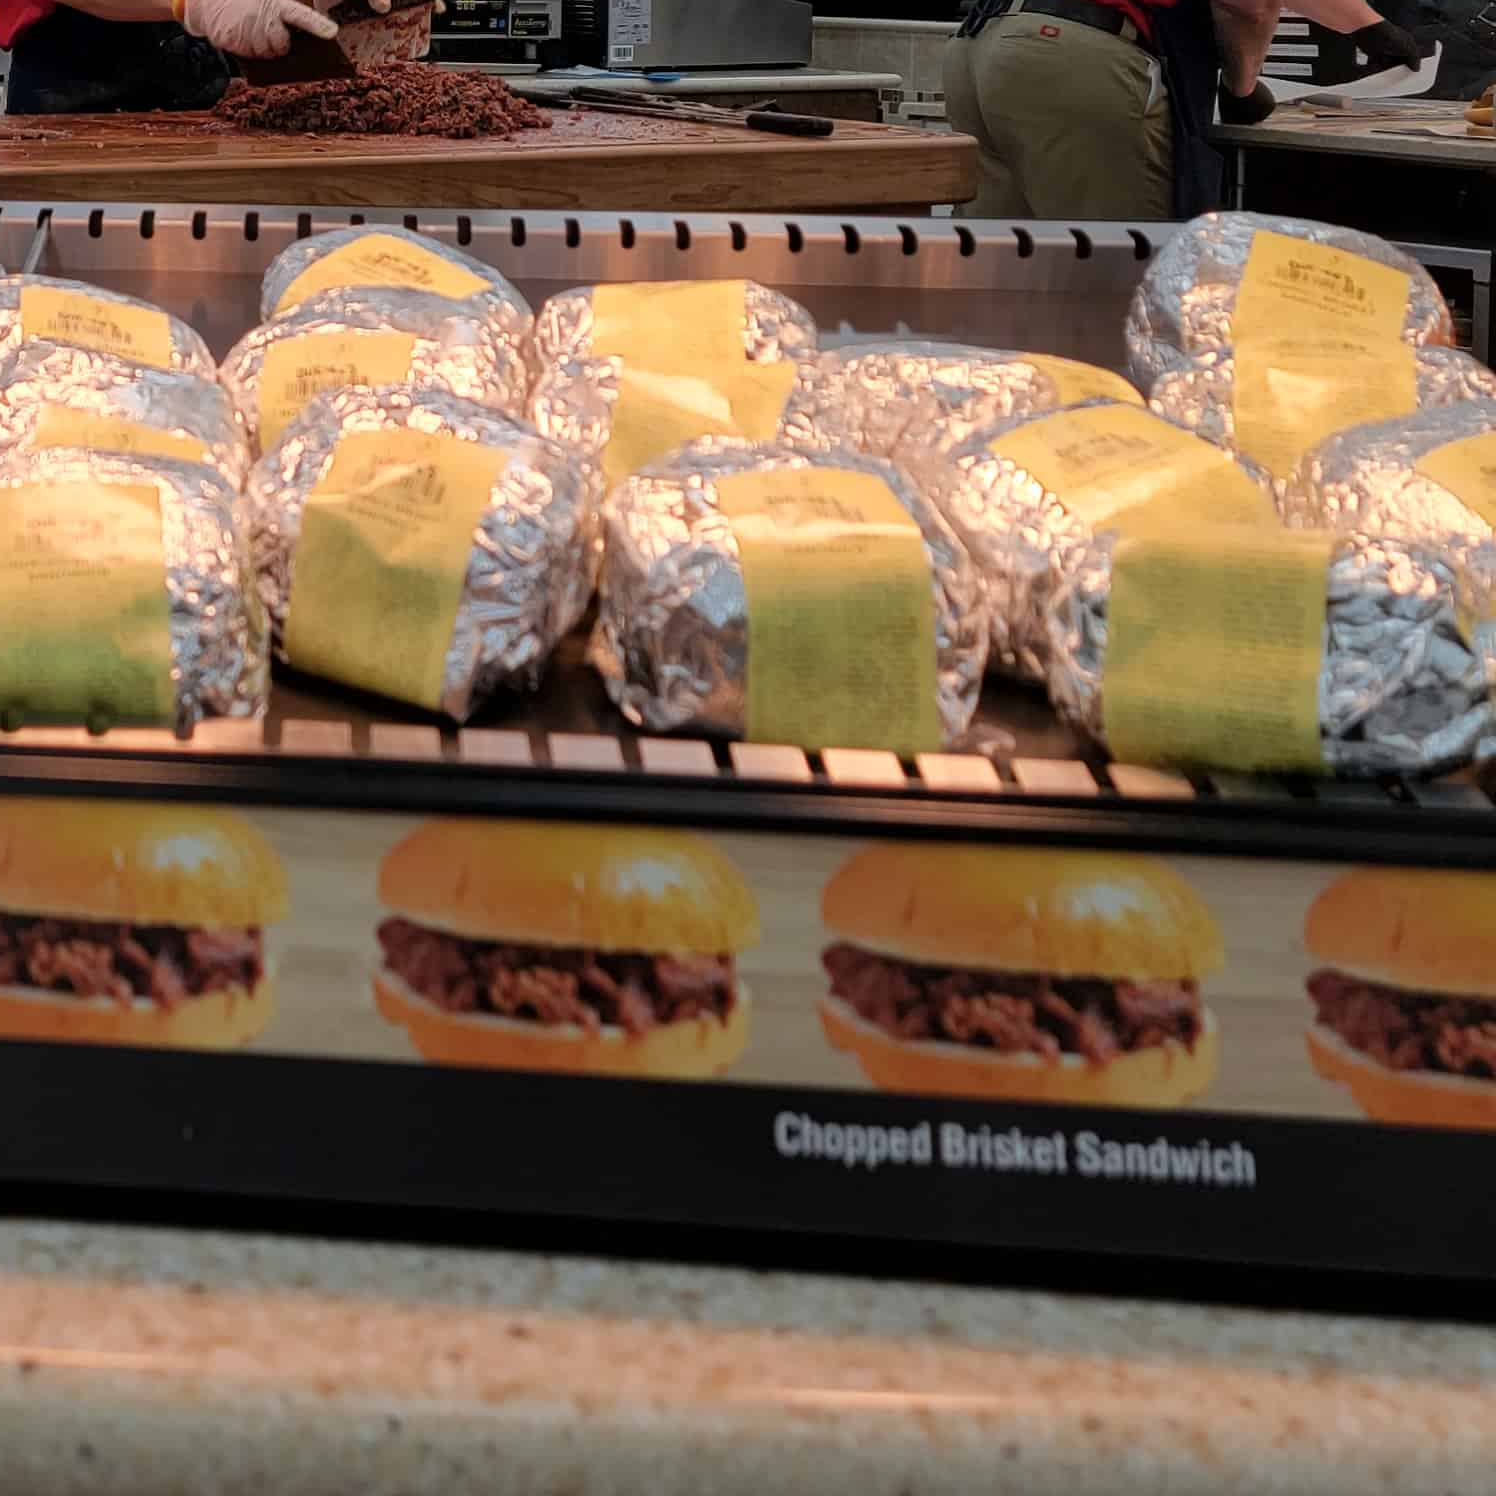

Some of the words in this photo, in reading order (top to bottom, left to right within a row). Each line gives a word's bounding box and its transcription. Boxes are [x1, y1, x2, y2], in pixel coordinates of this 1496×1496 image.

[773, 1110, 934, 1169] Chopped
[940, 1120, 1069, 1174] Brisket
[1075, 1130, 1259, 1188] Sandwich
